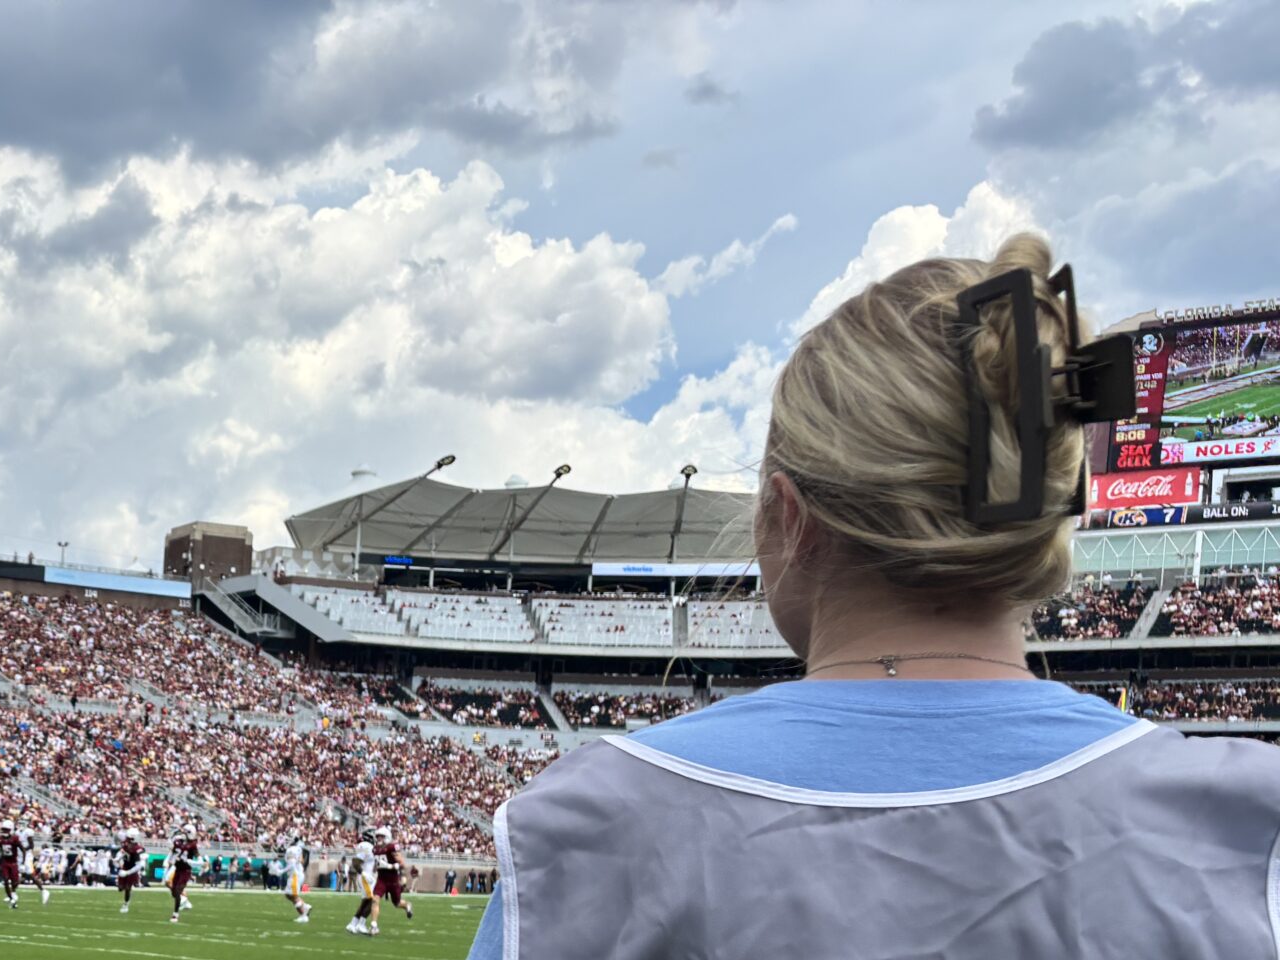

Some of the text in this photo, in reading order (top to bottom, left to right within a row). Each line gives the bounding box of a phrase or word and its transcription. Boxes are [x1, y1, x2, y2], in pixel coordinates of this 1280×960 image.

[1163, 303, 1234, 324] FLORIDA
[1195, 441, 1256, 457] NOLES
[1163, 507, 1176, 523] 7
[1203, 505, 1249, 518] BALL ON:
